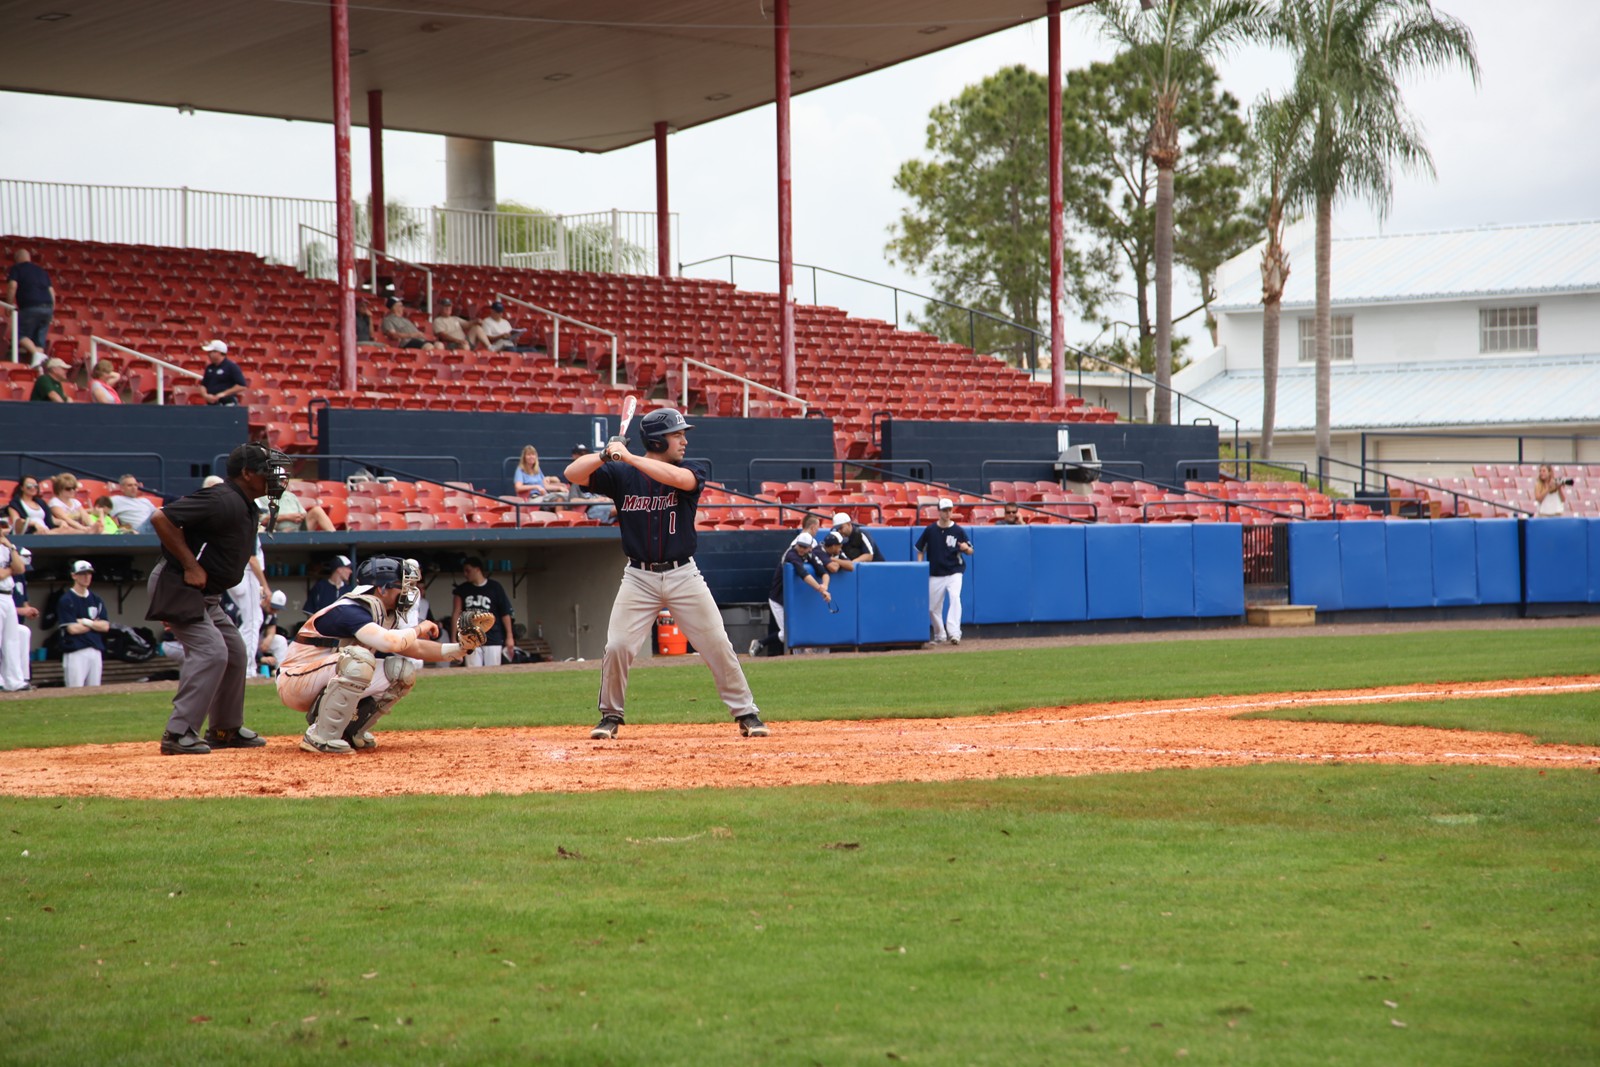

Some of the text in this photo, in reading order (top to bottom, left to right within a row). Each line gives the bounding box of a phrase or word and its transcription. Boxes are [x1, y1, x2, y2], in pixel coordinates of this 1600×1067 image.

[595, 422, 605, 448] L
[669, 511, 676, 535] 1
[465, 594, 491, 610] SJC
